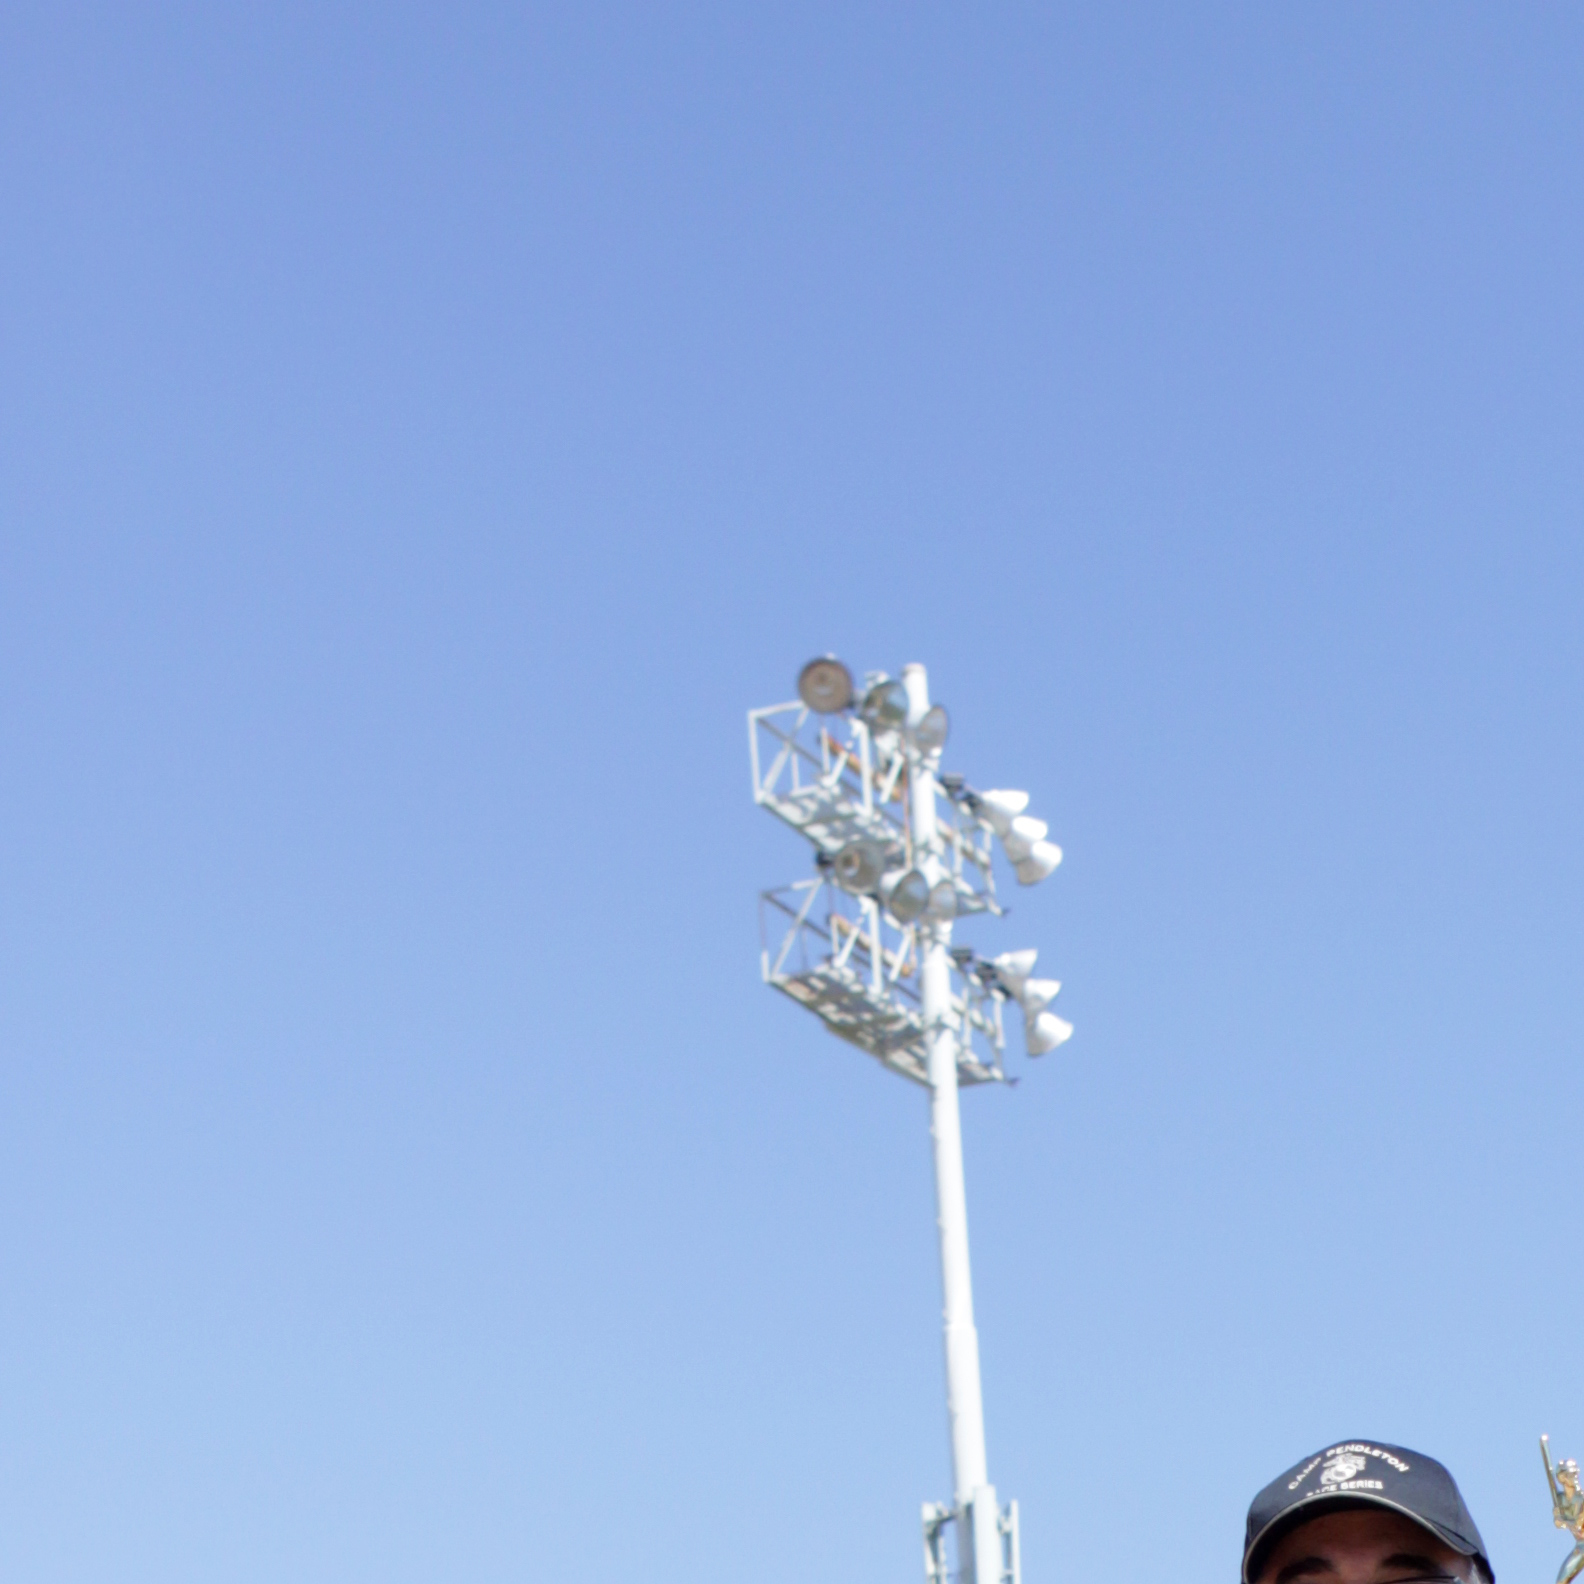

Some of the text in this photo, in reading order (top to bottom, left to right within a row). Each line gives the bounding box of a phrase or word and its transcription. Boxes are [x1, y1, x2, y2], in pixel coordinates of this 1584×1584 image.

[1288, 1444, 1410, 1490] CAMP PENDLETON
[1340, 1480, 1384, 1491] SERIES
